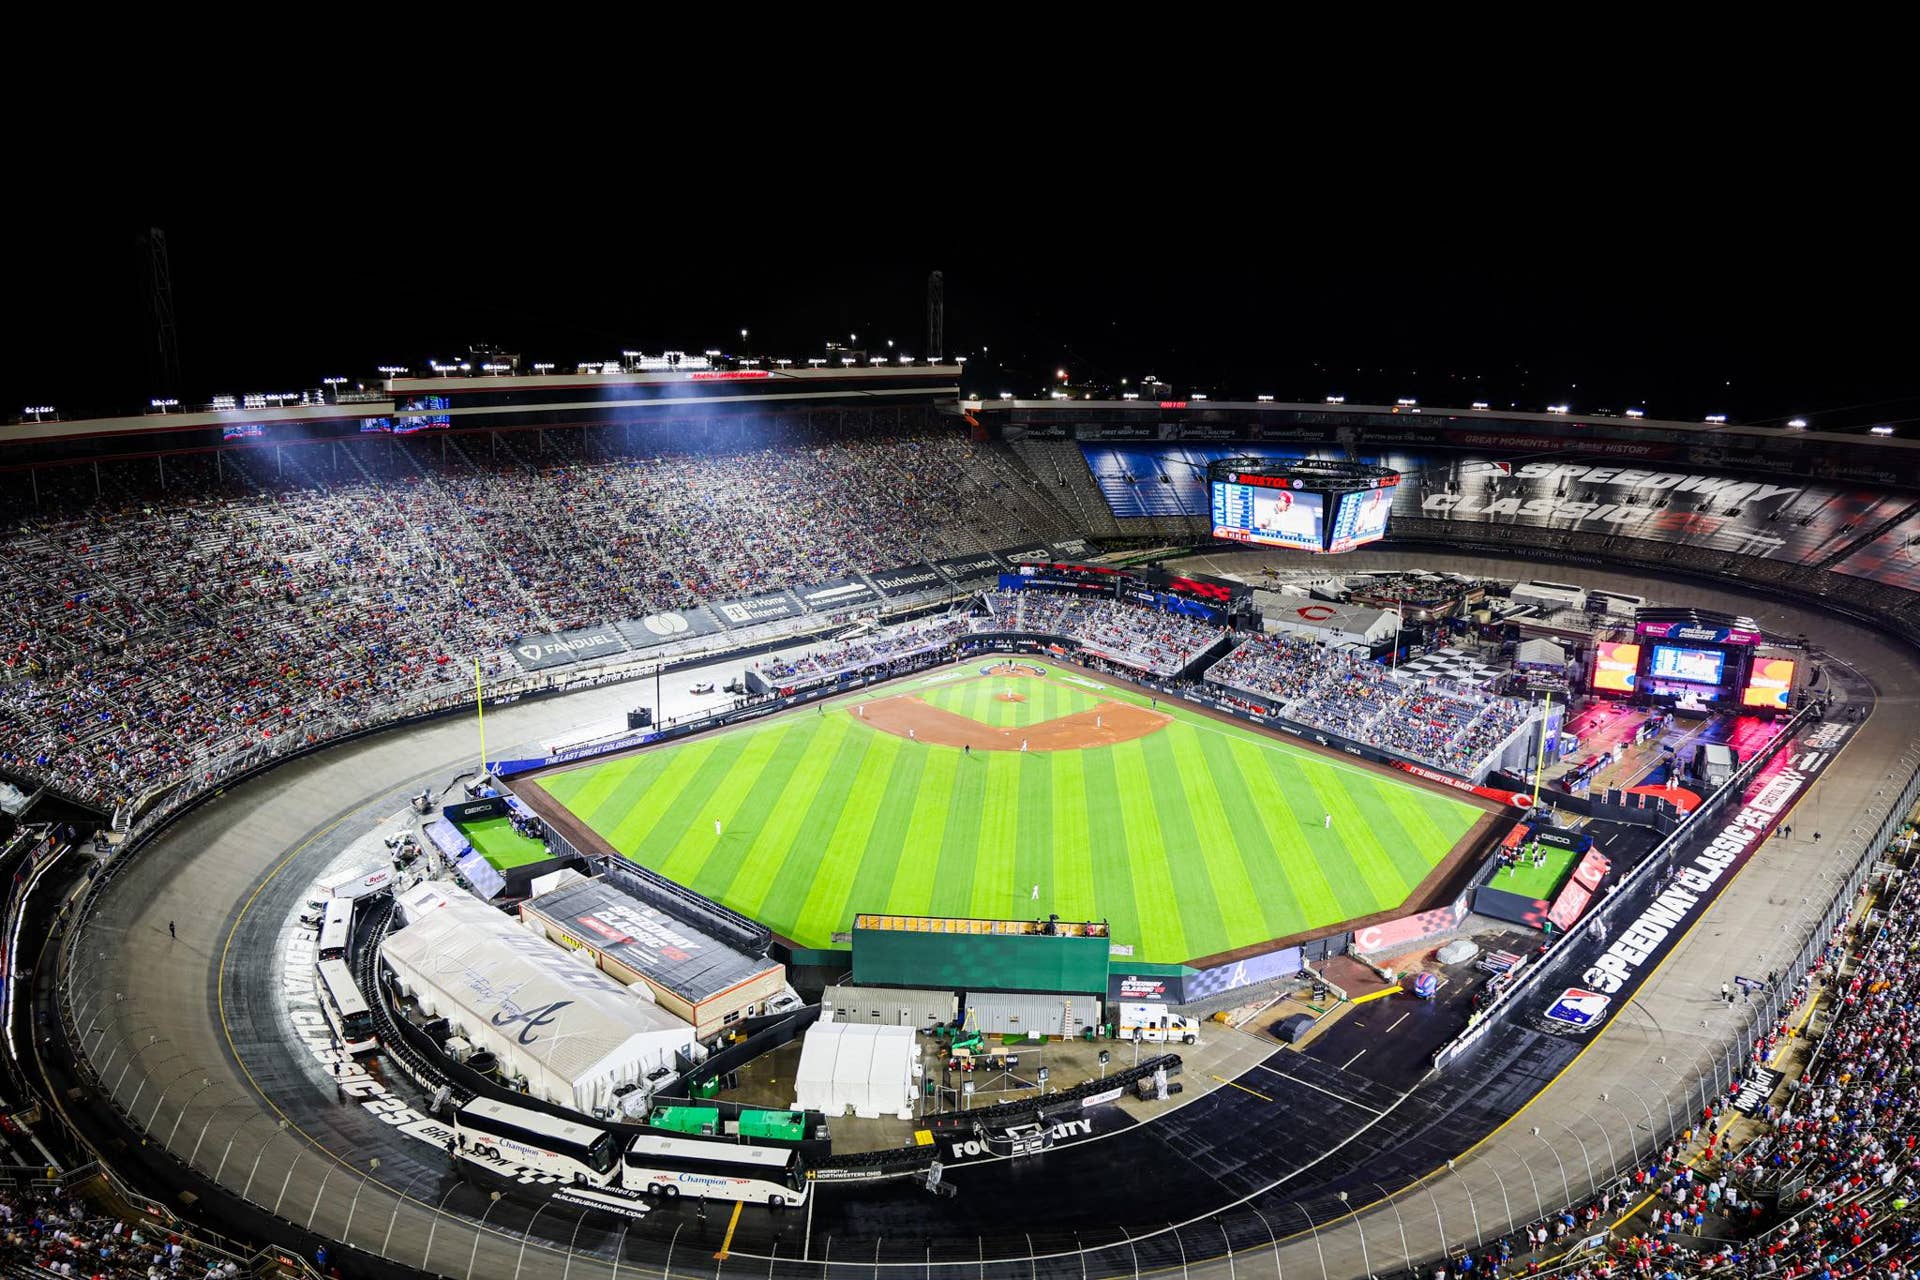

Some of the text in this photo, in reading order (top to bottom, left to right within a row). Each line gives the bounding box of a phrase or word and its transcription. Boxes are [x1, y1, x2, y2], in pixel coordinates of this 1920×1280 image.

[1465, 434, 1497, 444] GREAT
[1499, 437, 1551, 448] MOMENTS
[1606, 445, 1651, 455] HISTORY
[1239, 474, 1289, 488] BRISTOL
[1514, 462, 1802, 502] SPEEDWAY
[1214, 483, 1225, 525] ATLANTA
[1420, 493, 1655, 525] CLASSIC
[1006, 549, 1049, 563] GEICO
[957, 559, 999, 574] BETMGM
[879, 572, 937, 589] Budweiser
[742, 597, 786, 609] 5G Home
[751, 606, 790, 619] Internet
[544, 634, 614, 655] FANDUEL
[596, 673, 621, 684] MOTOR
[544, 754, 559, 765] THE
[559, 751, 578, 762] LAST
[578, 745, 602, 758] GREAT
[602, 736, 645, 753] COLOSSEUM
[1409, 766, 1425, 776] IT'S
[1454, 780, 1476, 792] BABY
[465, 804, 492, 815] GEICO
[1541, 832, 1571, 845] GEICO
[369, 873, 387, 884] Ryder
[1582, 882, 1700, 994] SPEEDWAY
[1685, 823, 1757, 893] CLASSIC
[592, 911, 668, 949] CLASSIC
[607, 904, 702, 950] SPEEDWAY
[361, 1092, 428, 1127] '25
[1734, 1090, 1760, 1112] FOOD
[499, 1137, 539, 1157] Champion
[679, 1172, 727, 1186] Champion
[628, 1190, 640, 1199] by
[551, 1192, 646, 1219] BUILDSUBMARINES.COM
